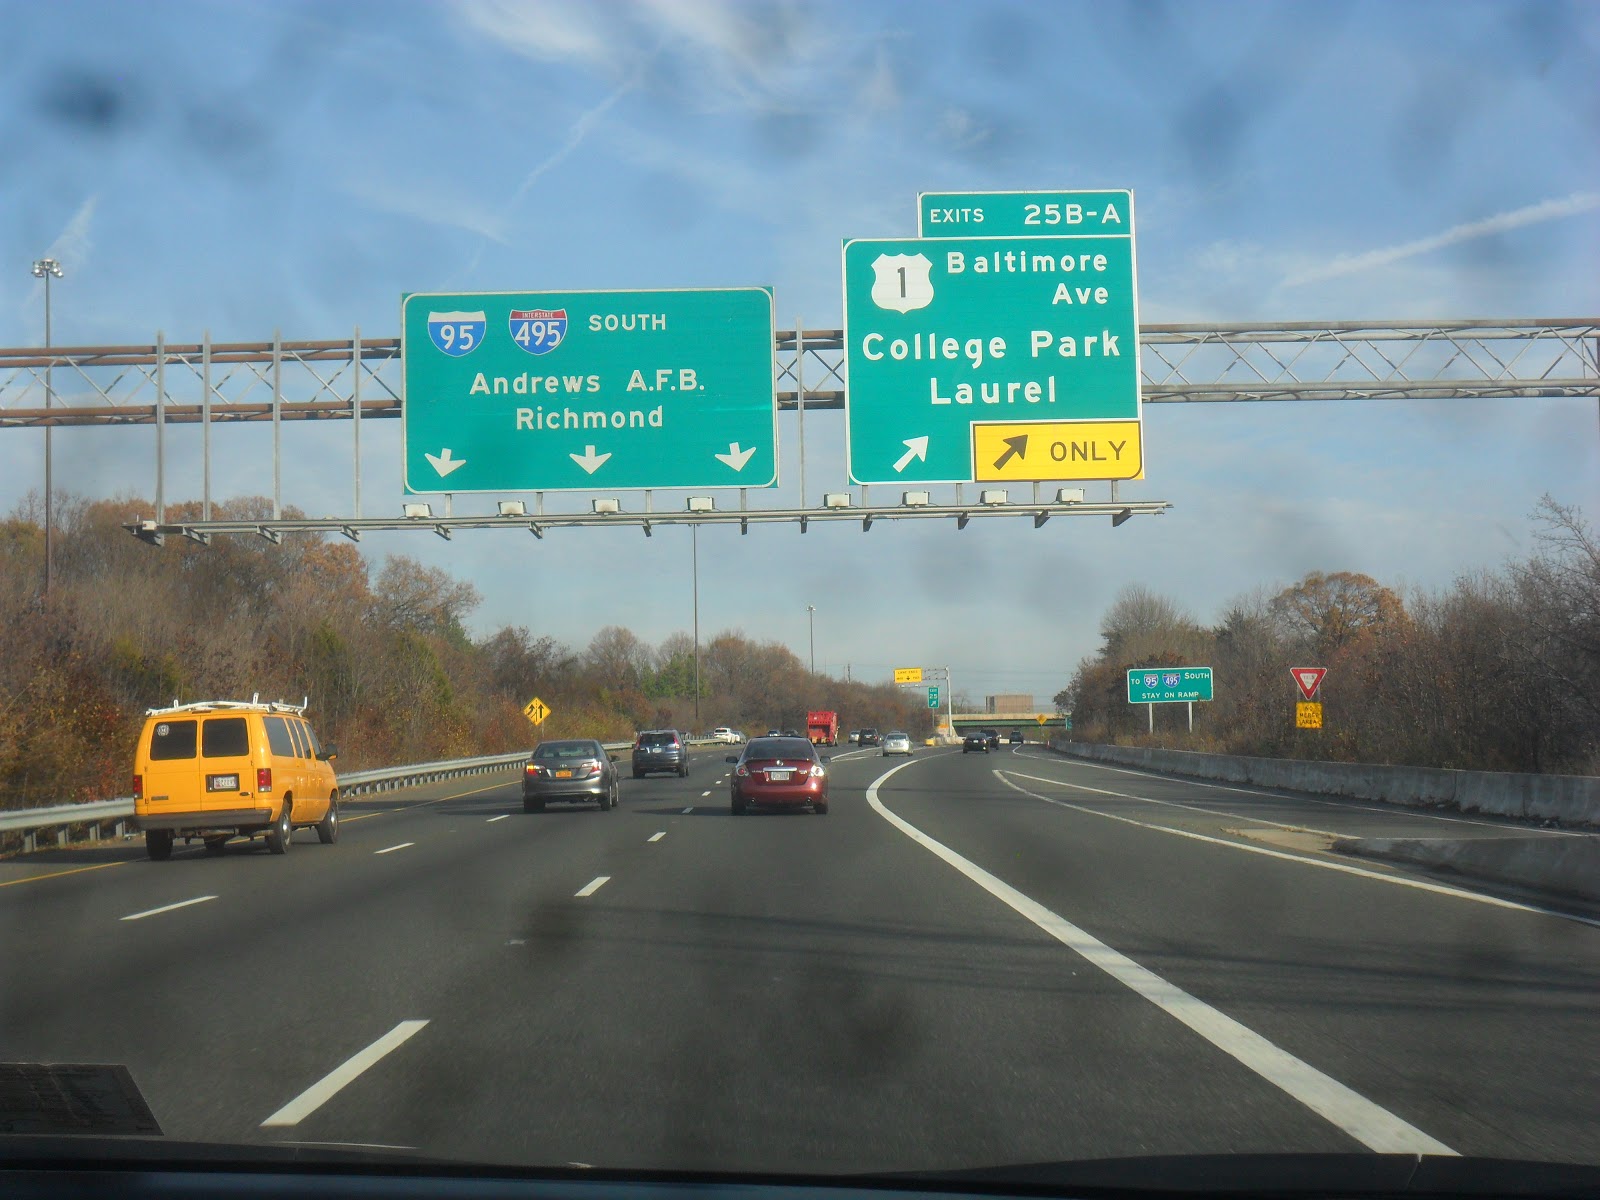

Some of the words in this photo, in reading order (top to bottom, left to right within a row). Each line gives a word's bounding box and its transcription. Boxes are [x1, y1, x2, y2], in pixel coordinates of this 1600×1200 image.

[930, 208, 984, 223] EXITS
[1024, 203, 1121, 225] 25B-A
[947, 251, 1108, 274] Baltimore
[897, 266, 907, 299] 1
[1052, 283, 1109, 305] Ave
[440, 323, 474, 351] 95
[514, 321, 561, 346] 495
[588, 314, 667, 331] SOUTH
[862, 332, 1007, 369] College
[1031, 330, 1121, 358] Park
[469, 372, 600, 395] Andrews
[626, 368, 706, 392] A.F.B.
[930, 376, 1056, 405] Laurel
[516, 405, 664, 430] Richmond
[1050, 440, 1127, 462] ONLY
[1145, 677, 1157, 686] 95
[1165, 676, 1178, 686] 495
